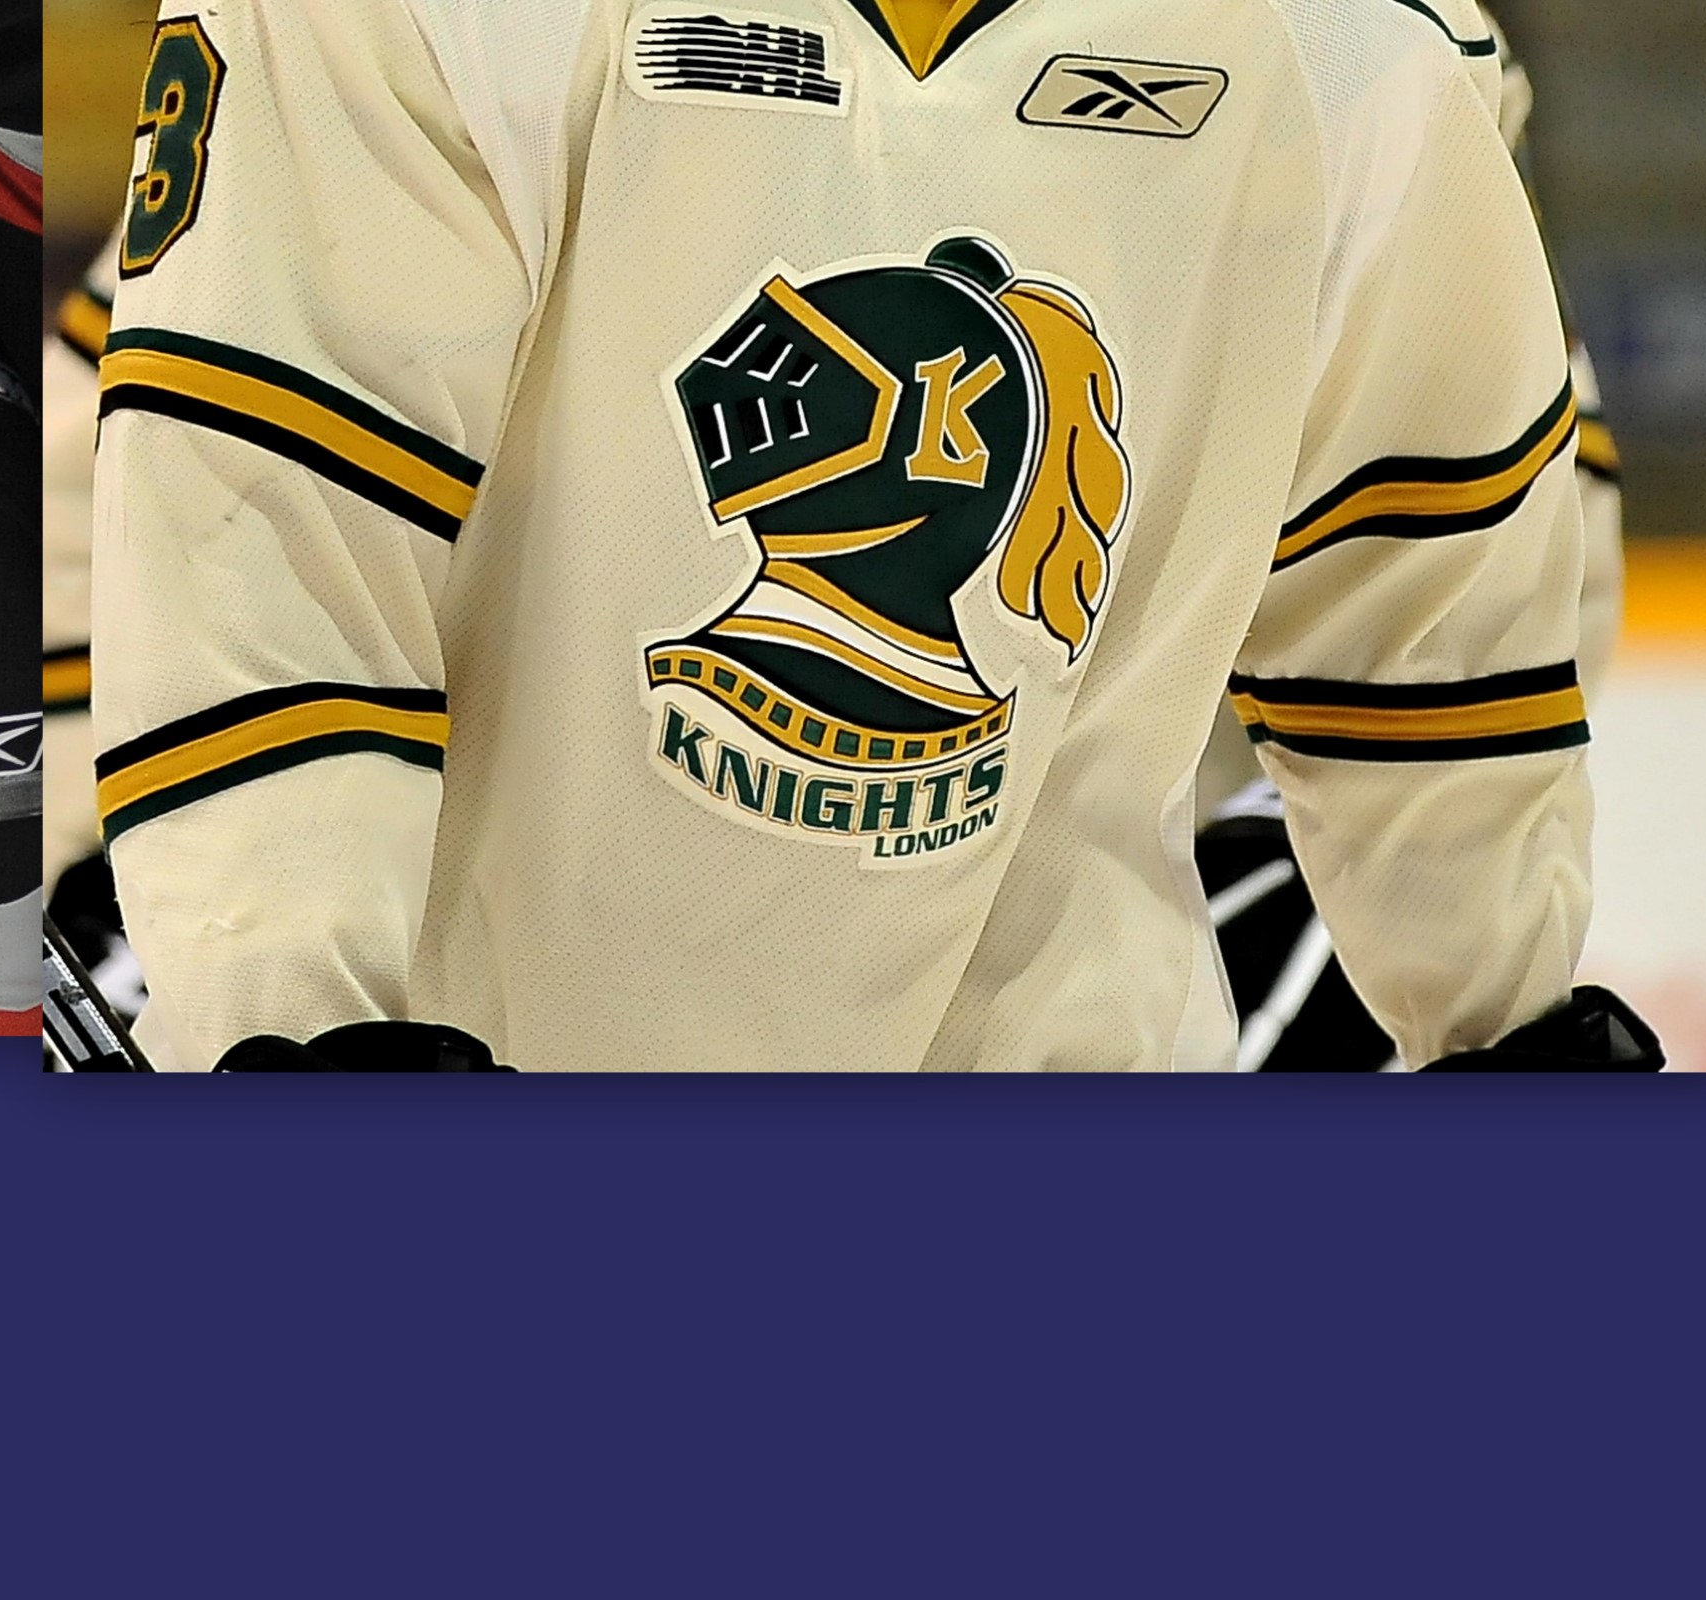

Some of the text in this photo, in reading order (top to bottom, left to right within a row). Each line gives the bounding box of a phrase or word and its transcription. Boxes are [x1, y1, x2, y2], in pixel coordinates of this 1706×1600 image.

[904, 345, 1007, 490] K
[658, 702, 1009, 834] KNIGHTS
[873, 802, 1000, 858] LONDON
